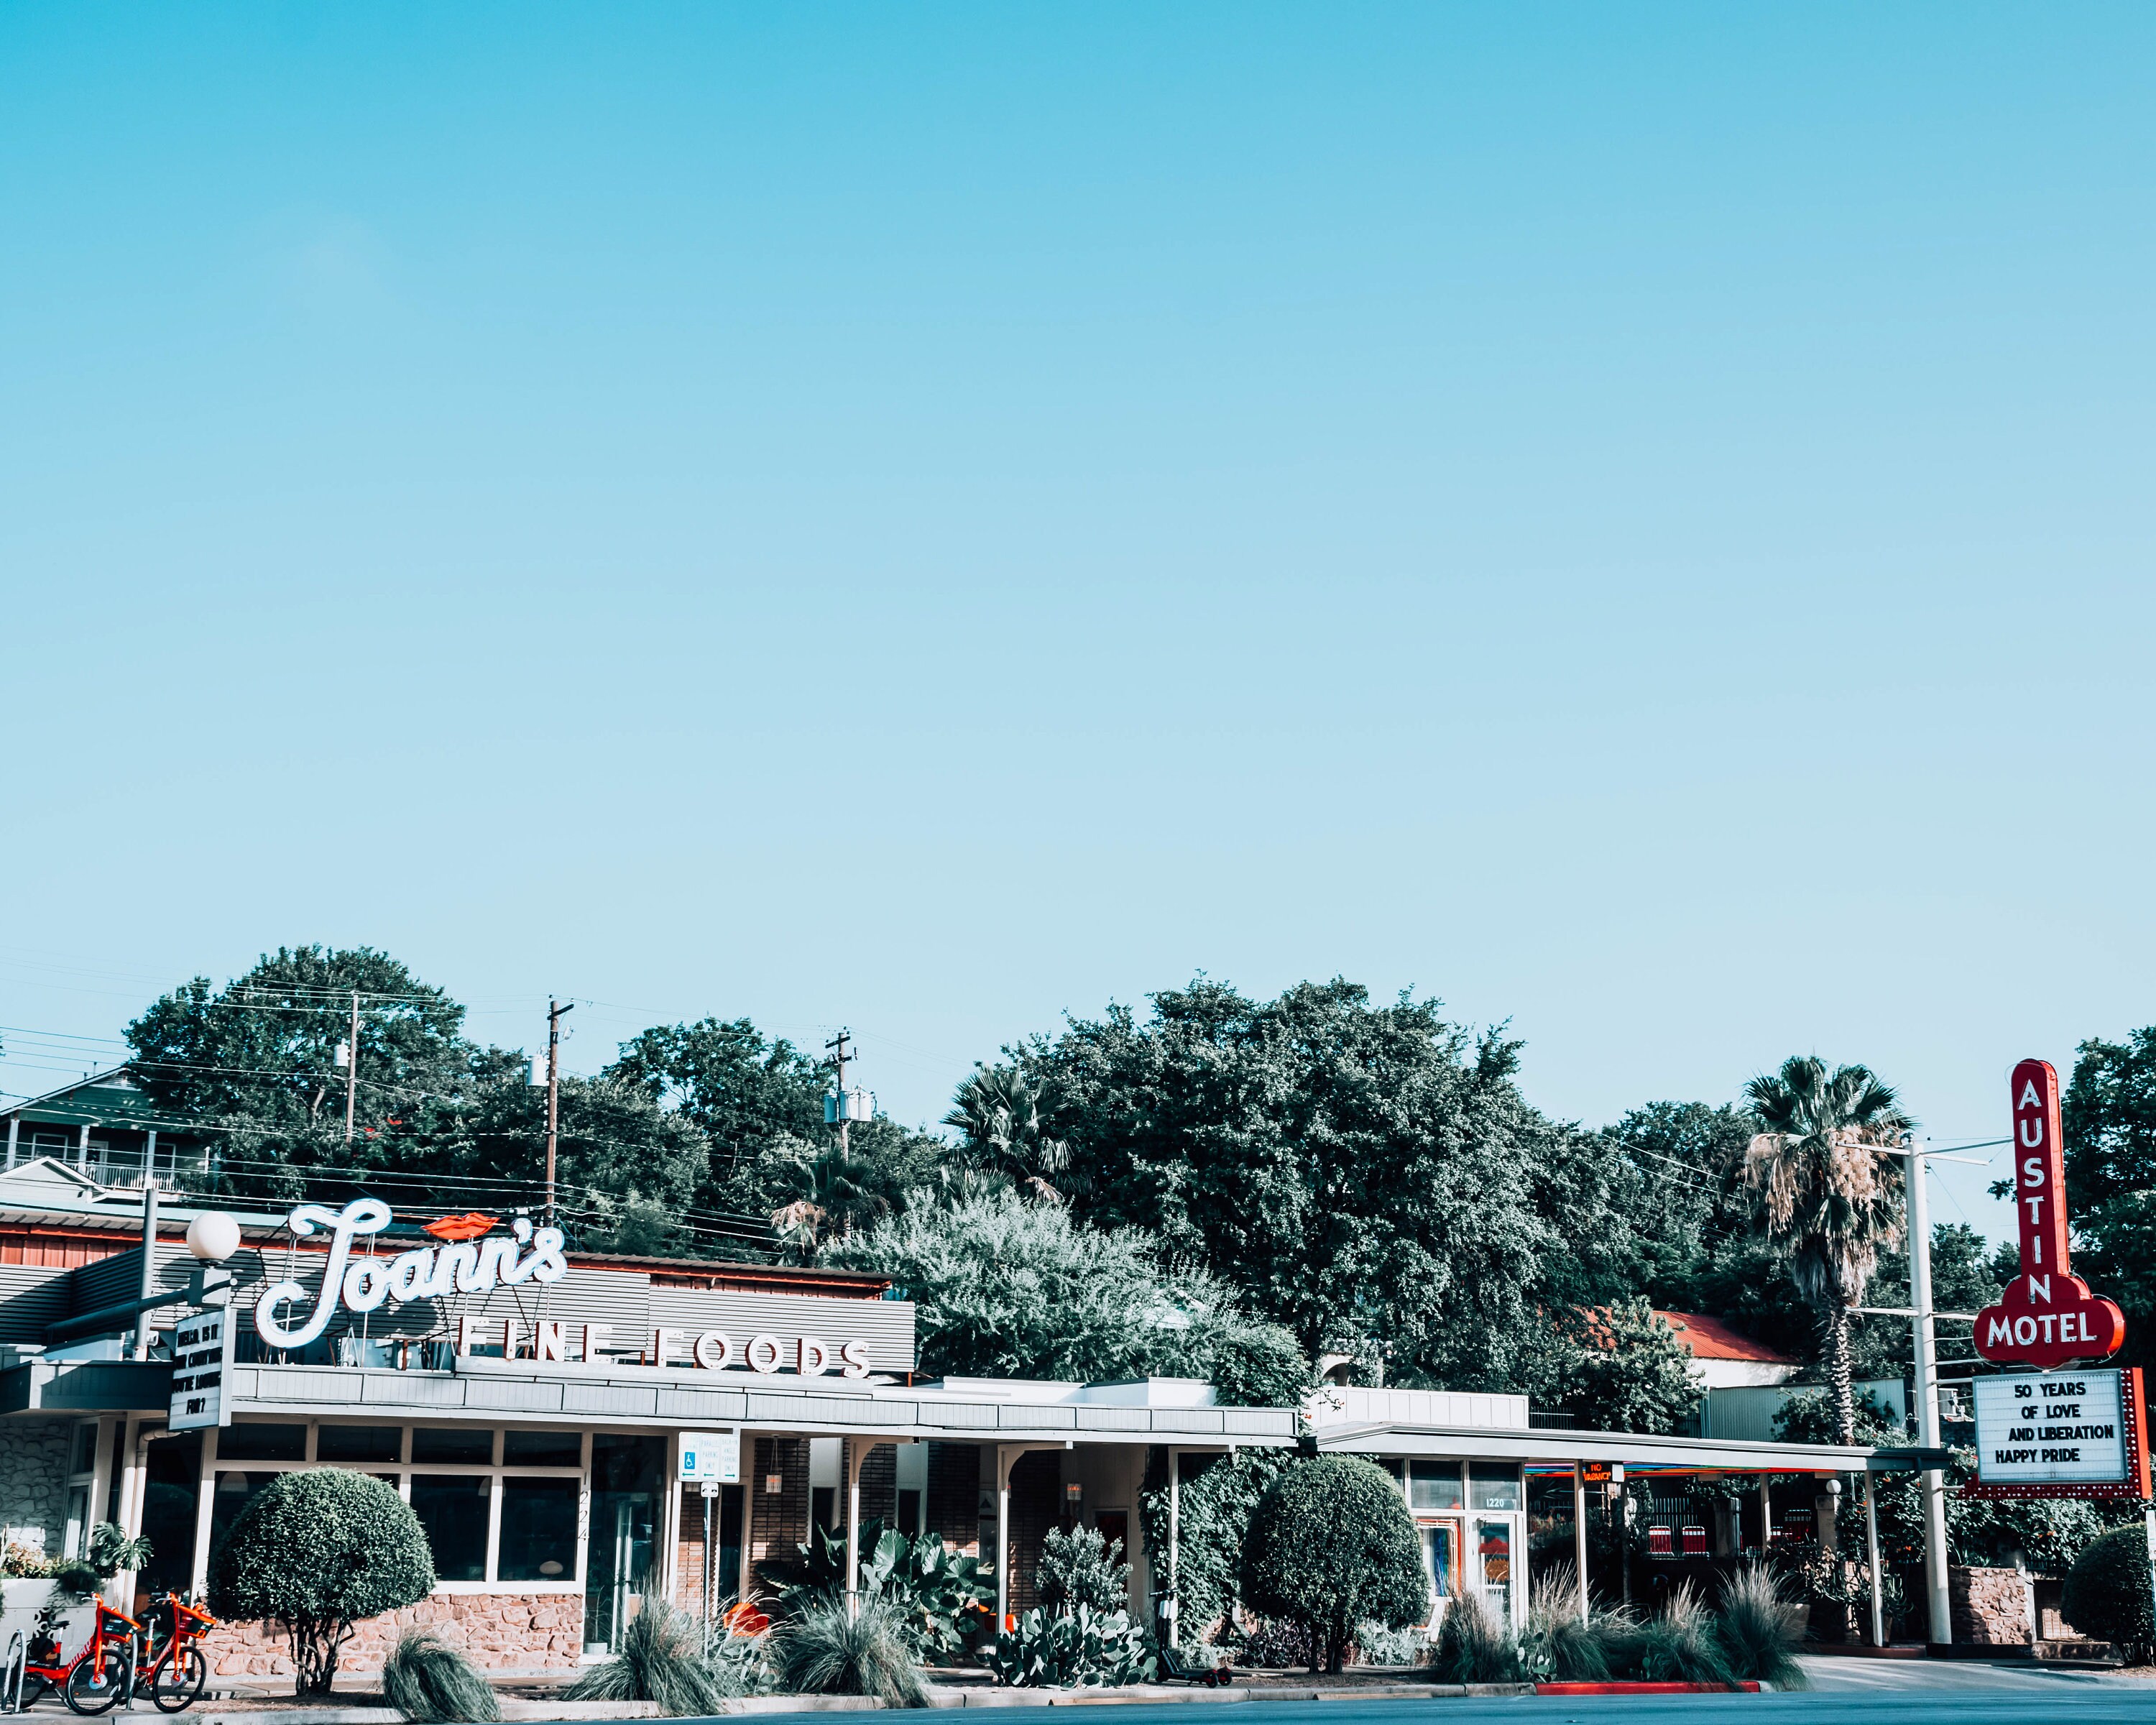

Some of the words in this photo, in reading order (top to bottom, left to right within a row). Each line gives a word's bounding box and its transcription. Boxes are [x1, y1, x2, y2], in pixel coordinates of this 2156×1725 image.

[2017, 1079, 2052, 1304] AUSTIN
[254, 1198, 568, 1348] Joann's
[1986, 1312, 2097, 1348] MOTEL
[458, 1316, 612, 1363] FINE
[654, 1329, 871, 1379] FOODS
[2014, 1384, 2032, 1398] 50
[2040, 1382, 2086, 1397] YEARS
[2021, 1405, 2038, 1420] OF
[2045, 1404, 2081, 1419] LOVE
[2008, 1427, 2035, 1441] AND
[2037, 1425, 2114, 1441] LIBERATION
[1995, 1449, 2037, 1463] HAPPY
[2041, 1448, 2081, 1463] PRIDE
[1487, 1499, 1504, 1507] 1220
